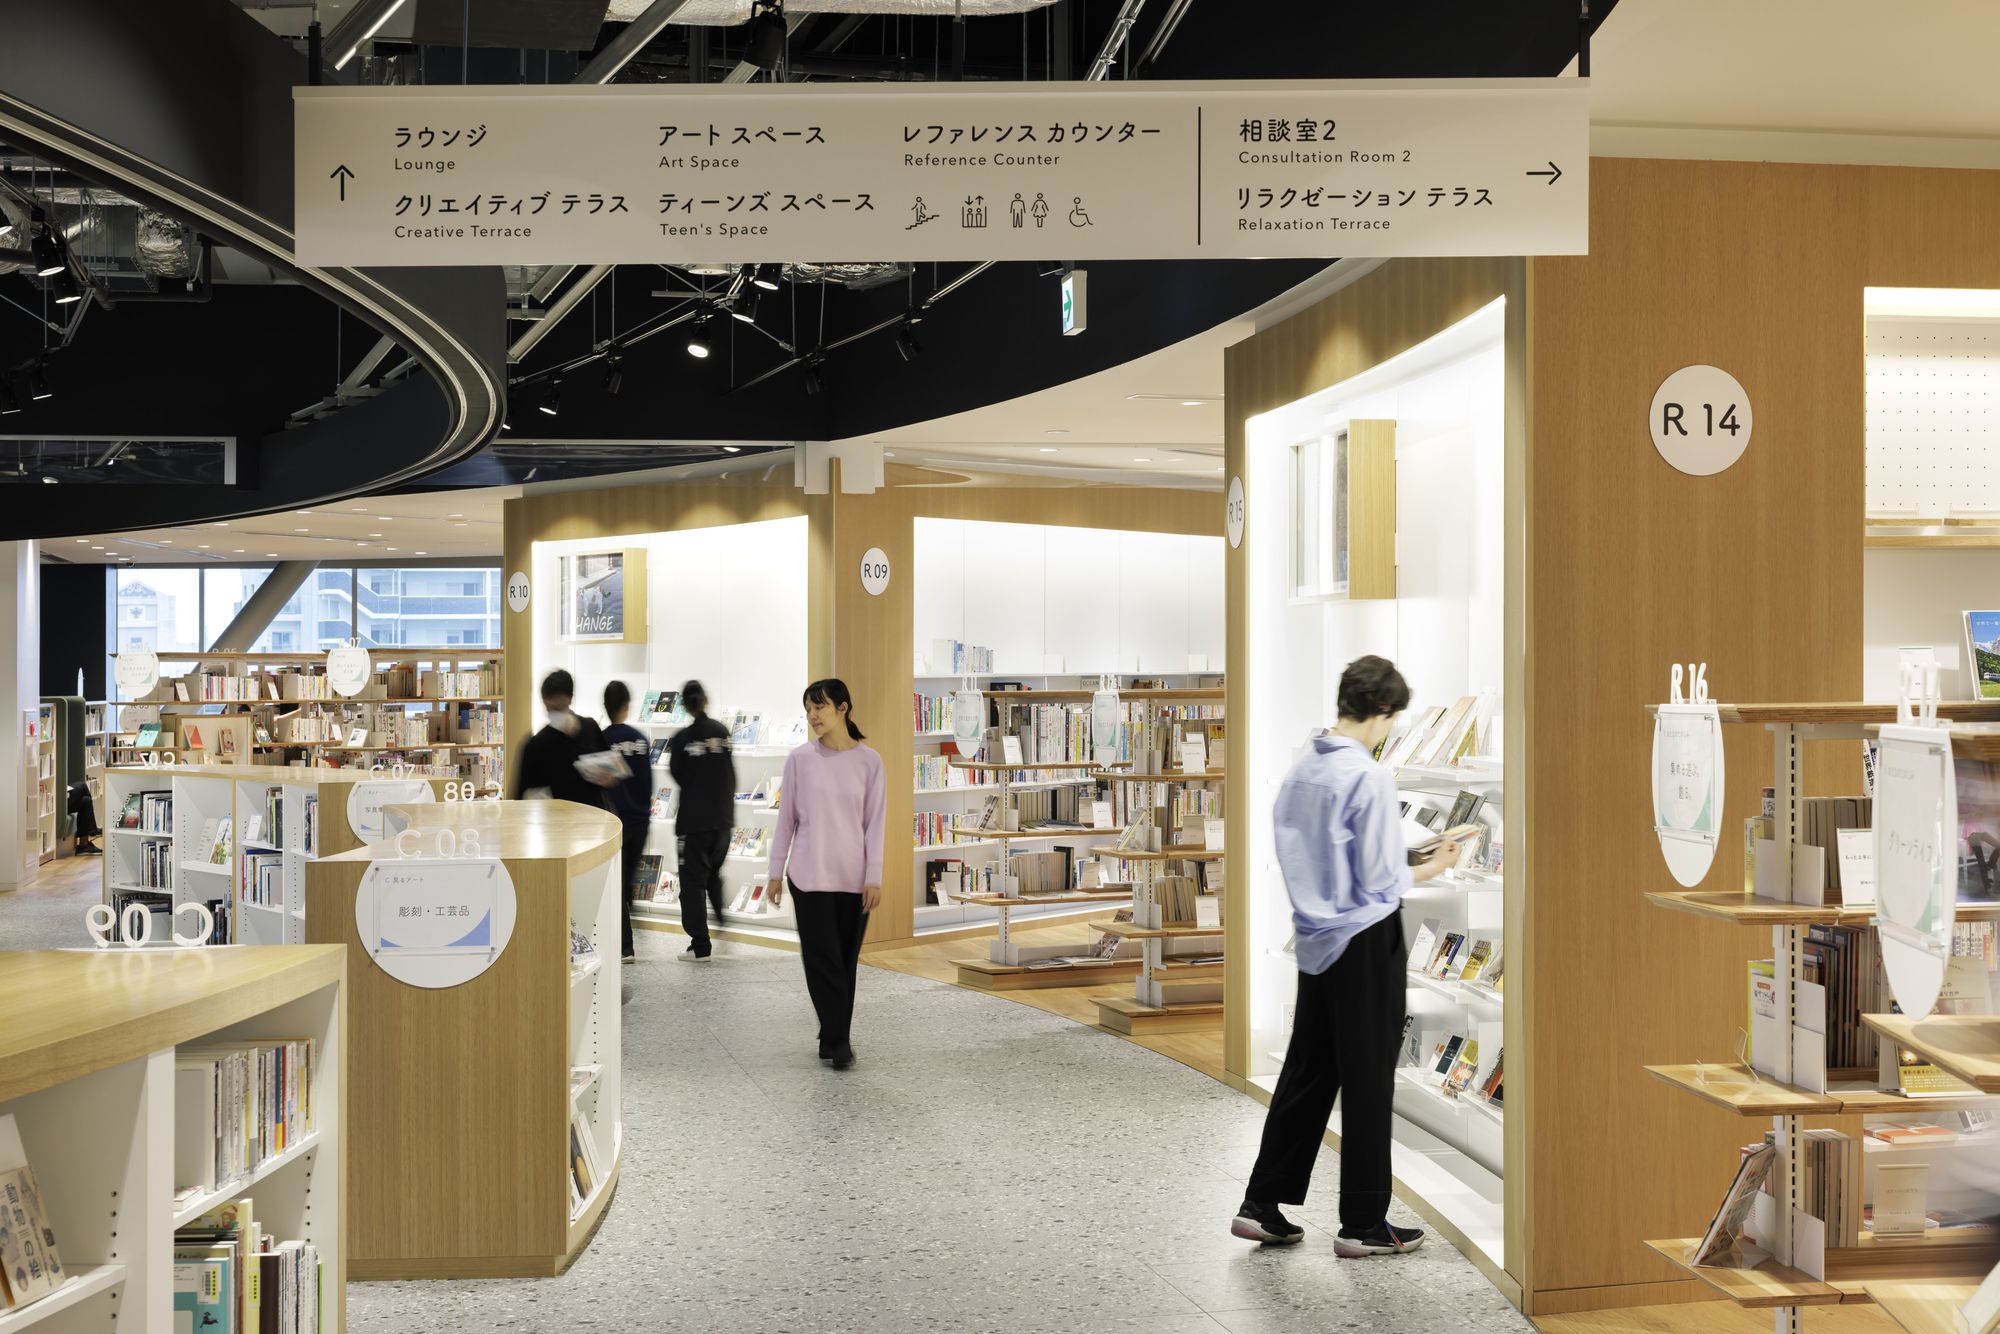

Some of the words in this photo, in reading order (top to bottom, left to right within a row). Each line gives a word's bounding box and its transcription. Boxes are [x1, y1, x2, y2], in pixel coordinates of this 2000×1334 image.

[395, 125, 487, 148] ラウンジ
[659, 124, 721, 147] アート
[731, 126, 825, 145] スペース
[904, 125, 1037, 145] レファレンス
[1047, 121, 1161, 144] カウンター
[1239, 117, 1336, 143] 相談室2
[394, 158, 456, 174] Lounge
[659, 155, 684, 168] Art
[690, 155, 740, 171] Space
[904, 153, 987, 166] Reference
[993, 153, 1060, 166] Counter
[1238, 150, 1343, 164] Consultation
[1350, 150, 1395, 163] Room
[1402, 150, 1411, 162] 2
[395, 190, 551, 217] クリエイティブ
[561, 193, 629, 215] テラス
[659, 190, 771, 214] ティーンズ
[780, 193, 874, 212] スペース
[1238, 186, 1416, 210] リラクゼーション
[1427, 187, 1493, 207] テラス
[394, 225, 464, 238] Creative
[470, 225, 532, 238] Terrace
[660, 223, 712, 236] Teen's
[719, 222, 768, 239] Space
[1238, 217, 1324, 231] Relaxation
[1330, 217, 1390, 230] Terrace
[1663, 402, 1688, 436] R
[1703, 403, 1741, 436] 14
[1229, 502, 1234, 523] R
[1236, 500, 1243, 522] 15
[863, 563, 872, 579] R
[874, 563, 888, 579] 09
[510, 585, 516, 598] R
[519, 585, 528, 598] 10
[575, 615, 614, 632] HANGE
[1670, 663, 1683, 704] R
[1688, 662, 1709, 704] 16
[395, 829, 422, 858] C
[435, 828, 481, 858] 08
[398, 904, 471, 918] 彫刻・工芸品
